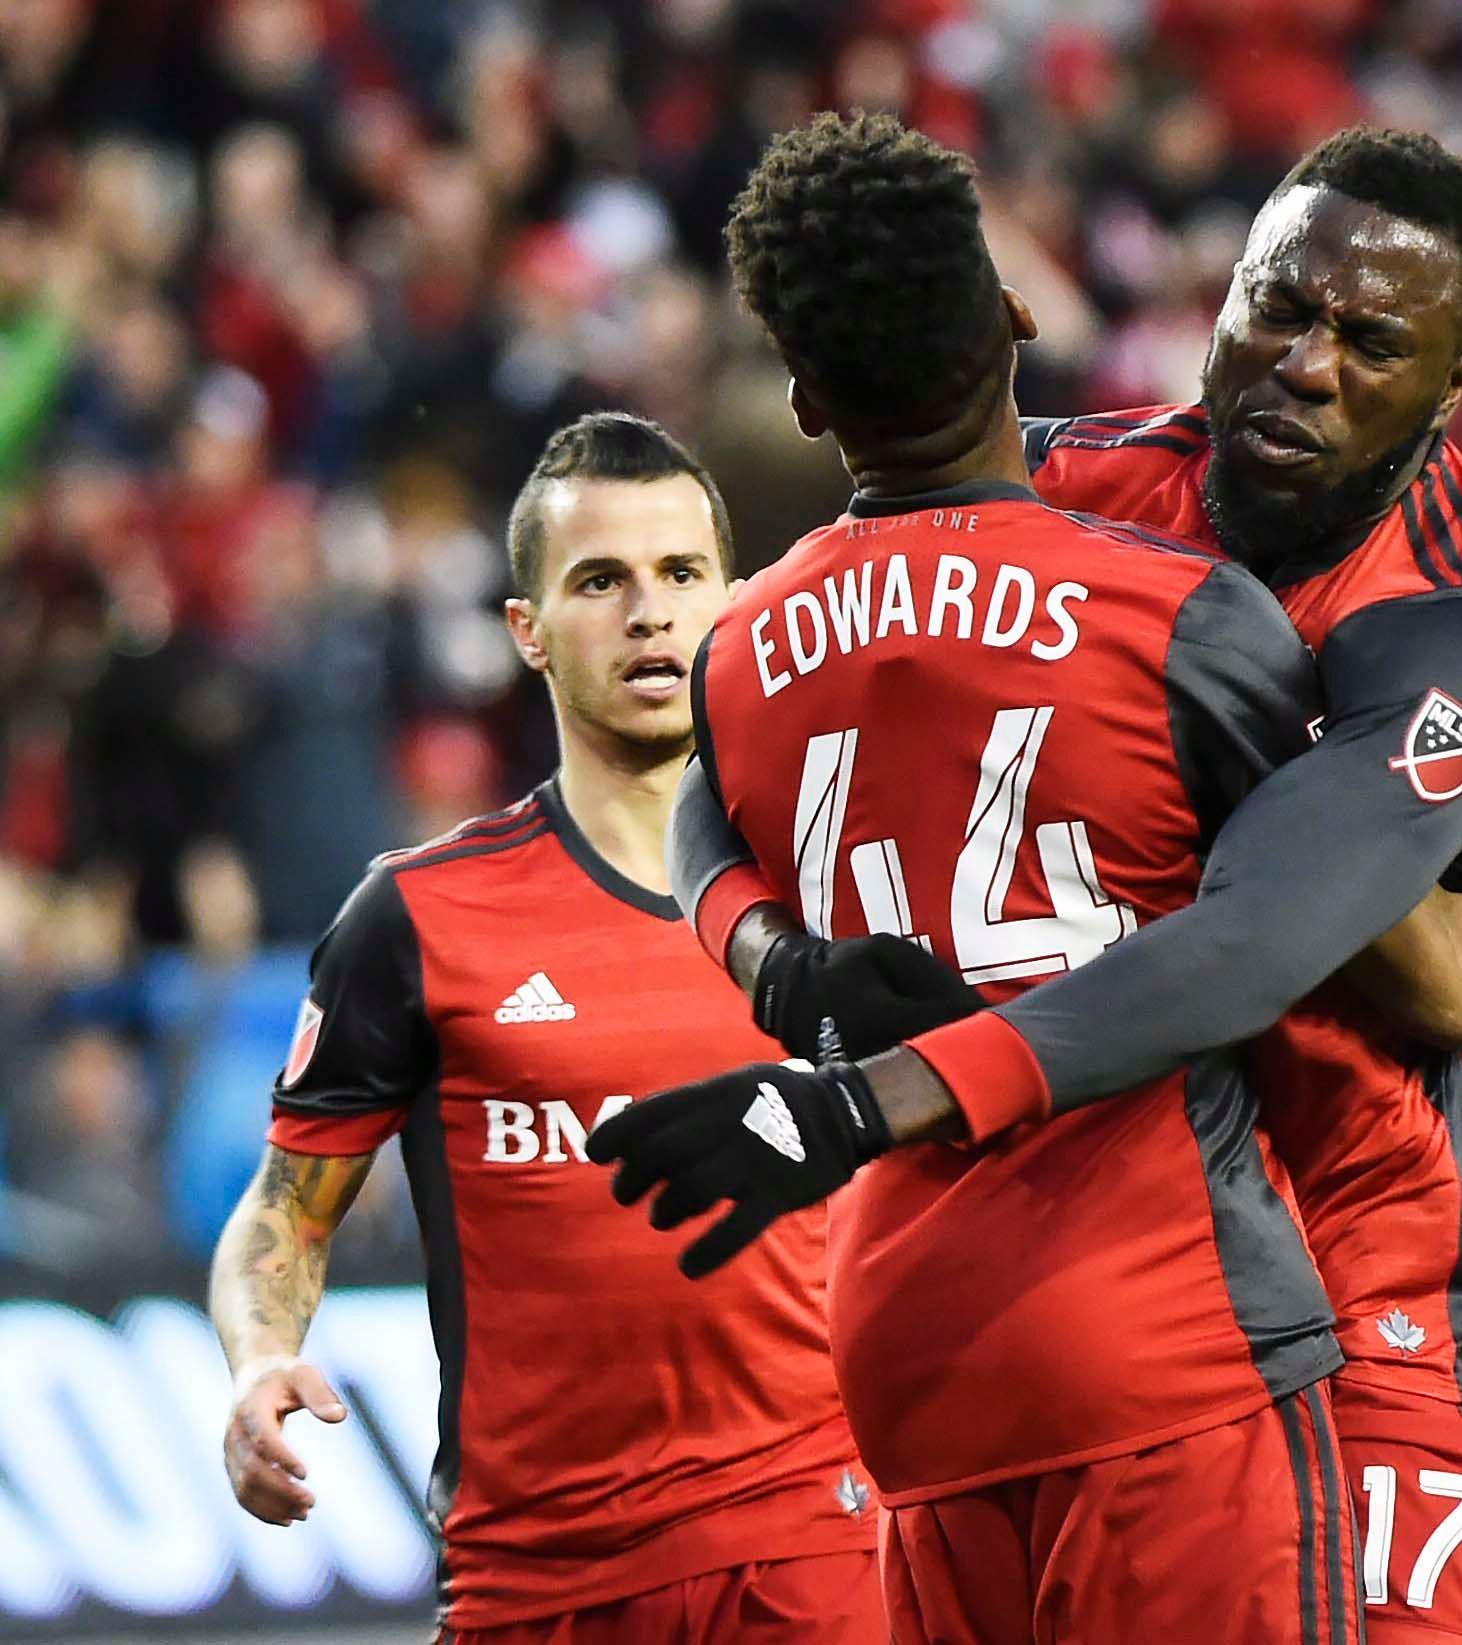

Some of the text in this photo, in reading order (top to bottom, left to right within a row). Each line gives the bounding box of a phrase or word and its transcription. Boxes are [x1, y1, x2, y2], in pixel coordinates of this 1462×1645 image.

[932, 510, 979, 533] ONE
[750, 553, 1090, 698] EDWARDS
[793, 705, 1138, 986] 44
[494, 1003, 576, 1025] adidas
[482, 1095, 633, 1164] BM
